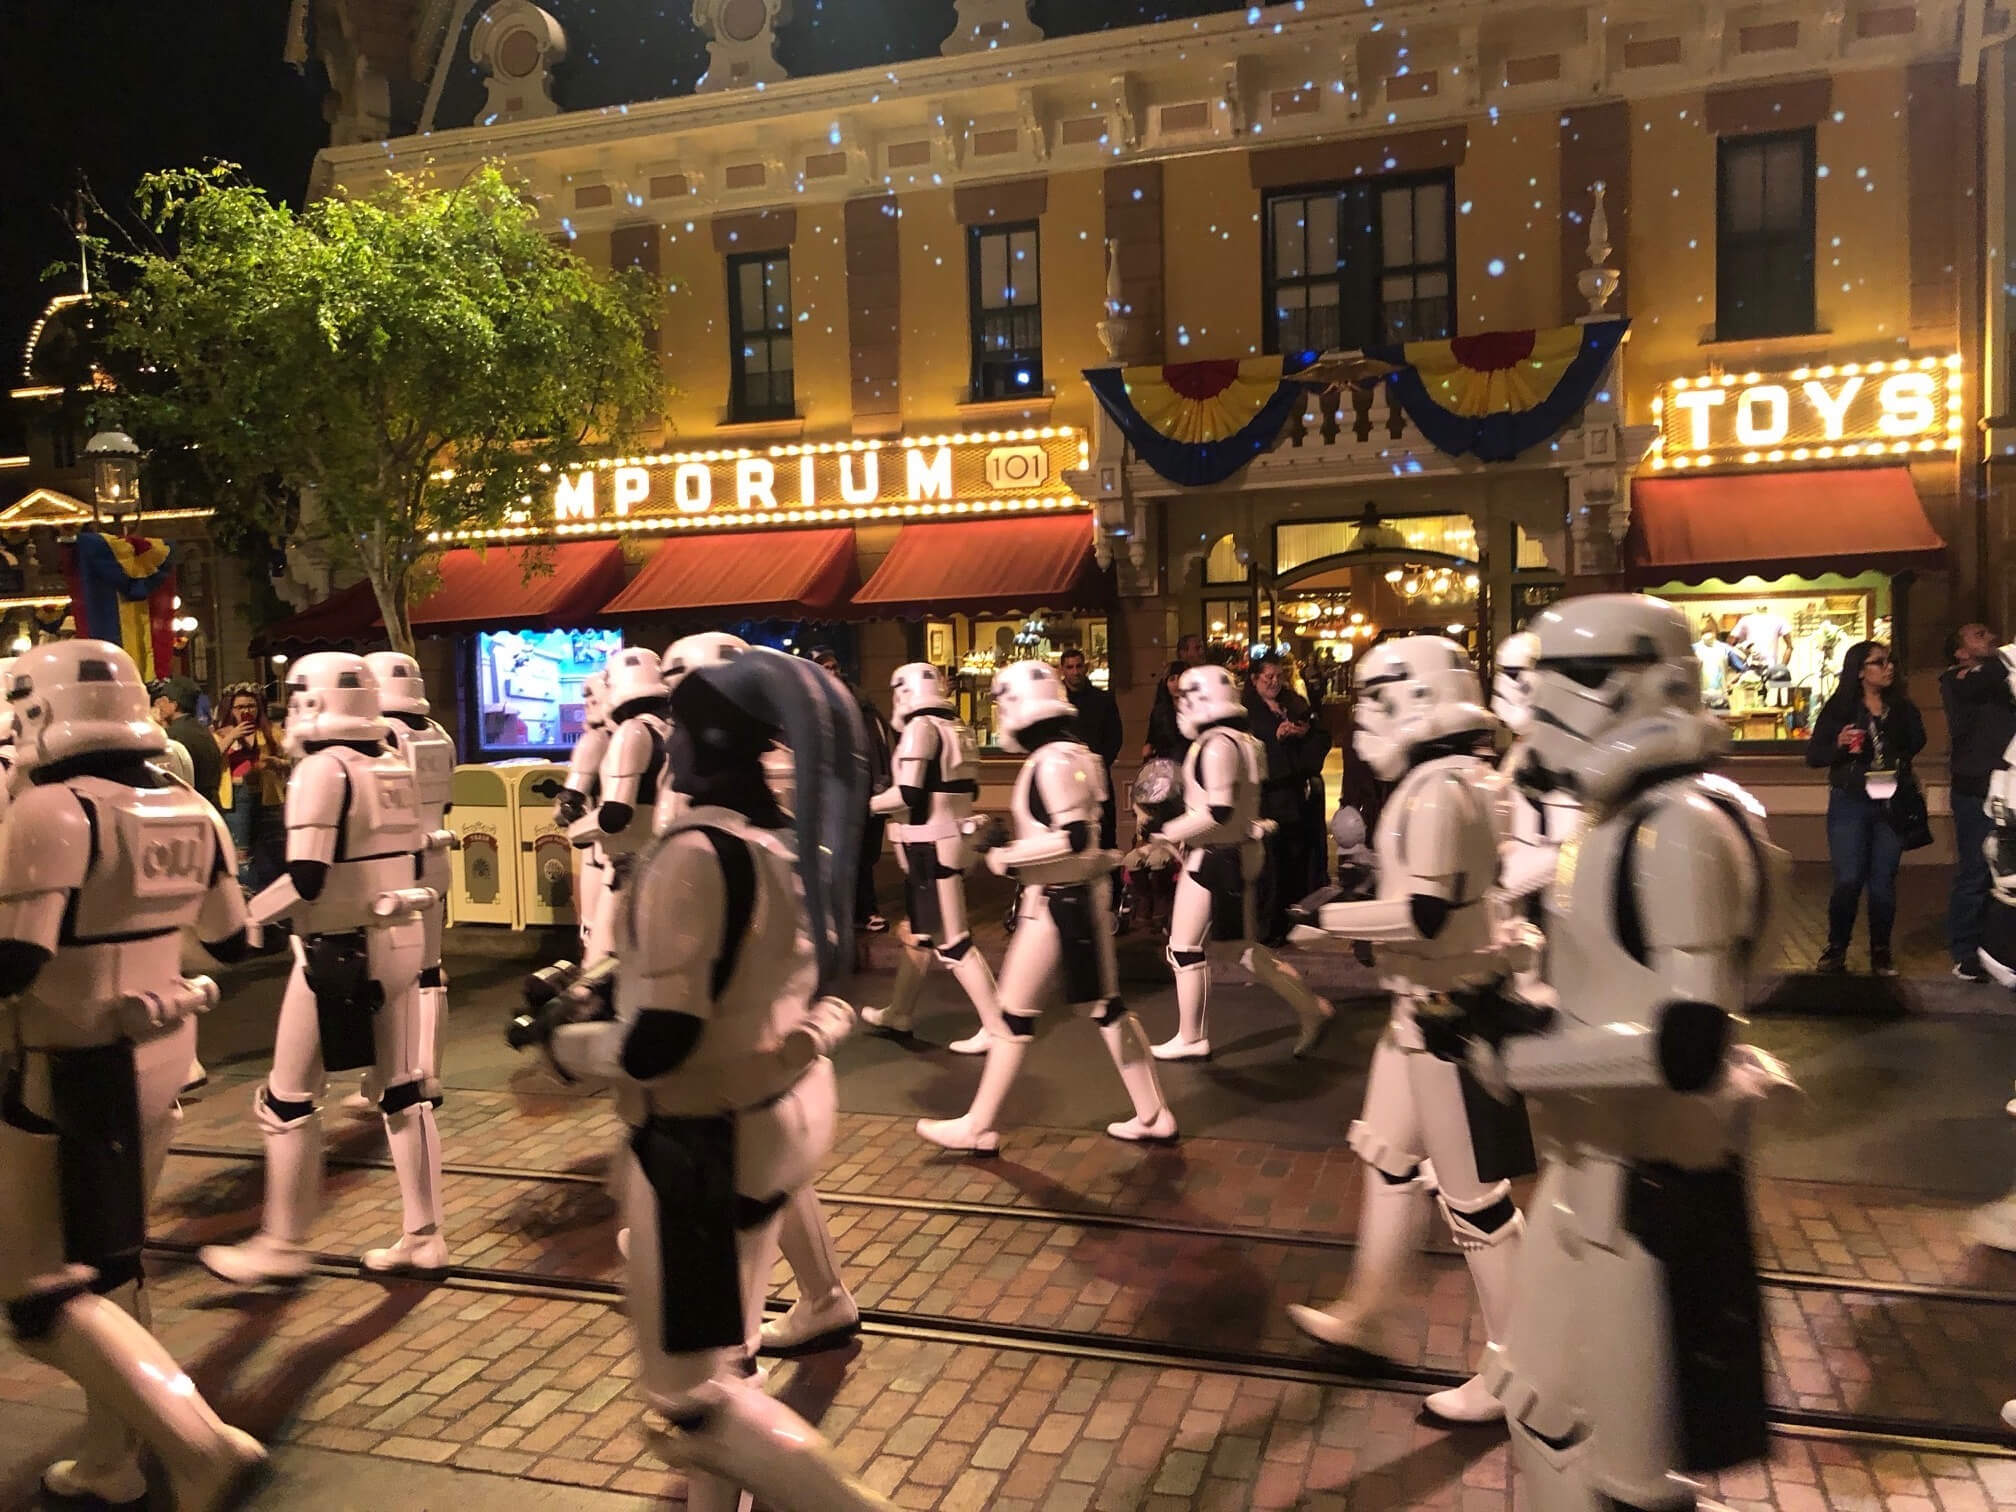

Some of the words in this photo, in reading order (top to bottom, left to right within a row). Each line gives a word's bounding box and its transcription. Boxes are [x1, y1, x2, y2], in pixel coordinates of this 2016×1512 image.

[1675, 372, 1936, 450] TOYS
[503, 447, 952, 523] MPORIUM
[992, 454, 1039, 481] 101
